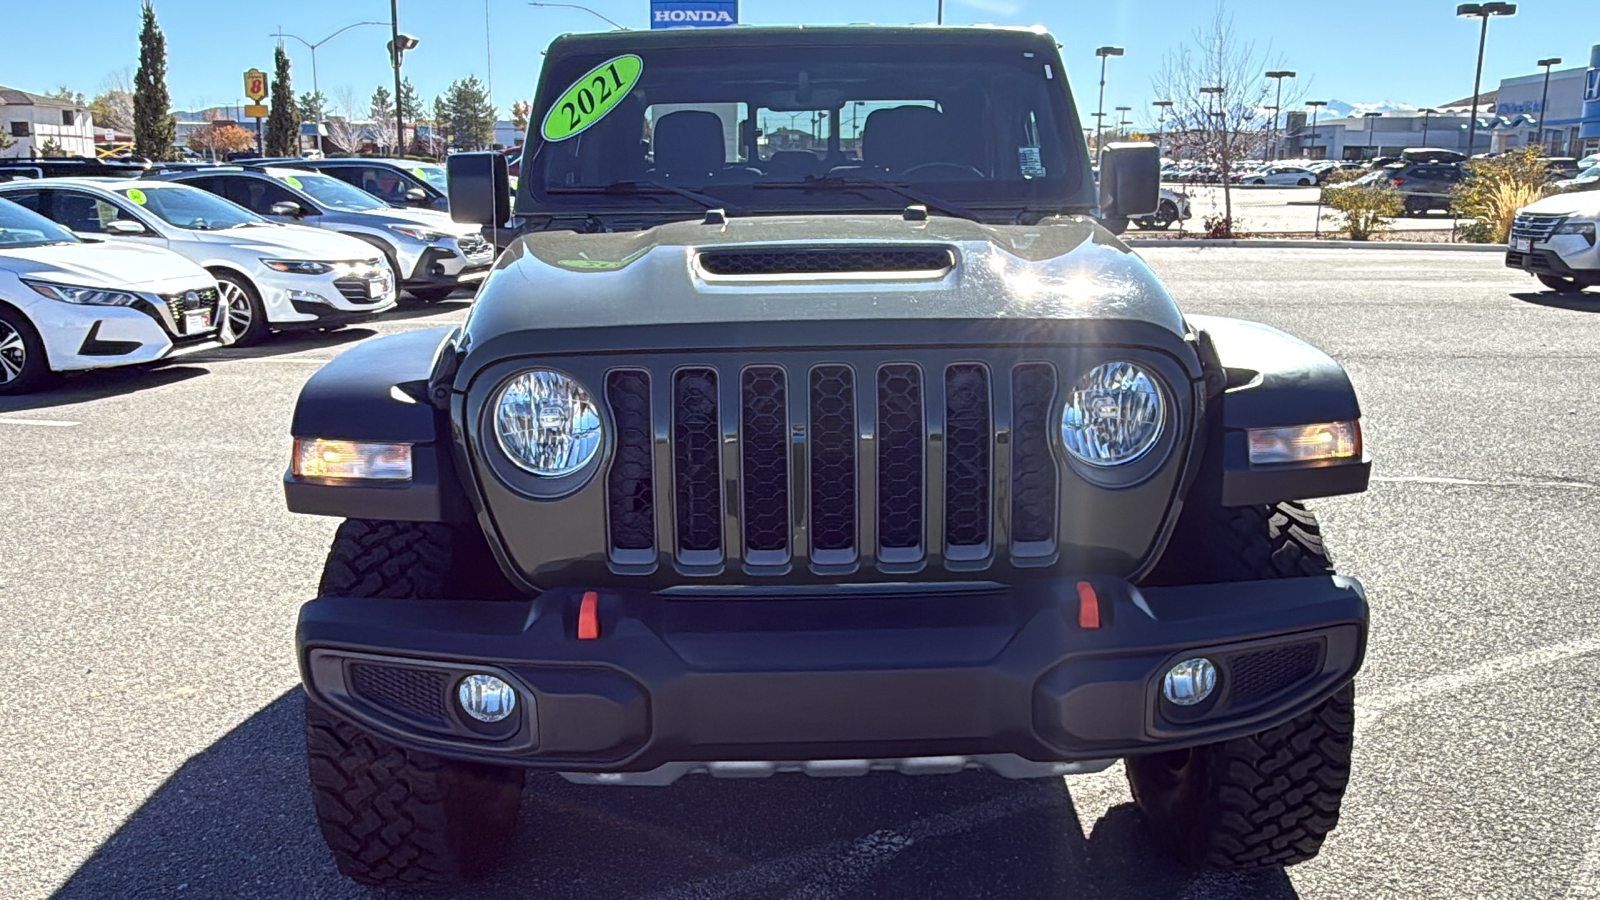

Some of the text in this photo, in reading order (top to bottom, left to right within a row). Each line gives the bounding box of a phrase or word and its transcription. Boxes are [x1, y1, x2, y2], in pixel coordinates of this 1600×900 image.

[654, 10, 734, 22] HONDA
[250, 79, 262, 94] 8
[561, 63, 626, 131] 2021
